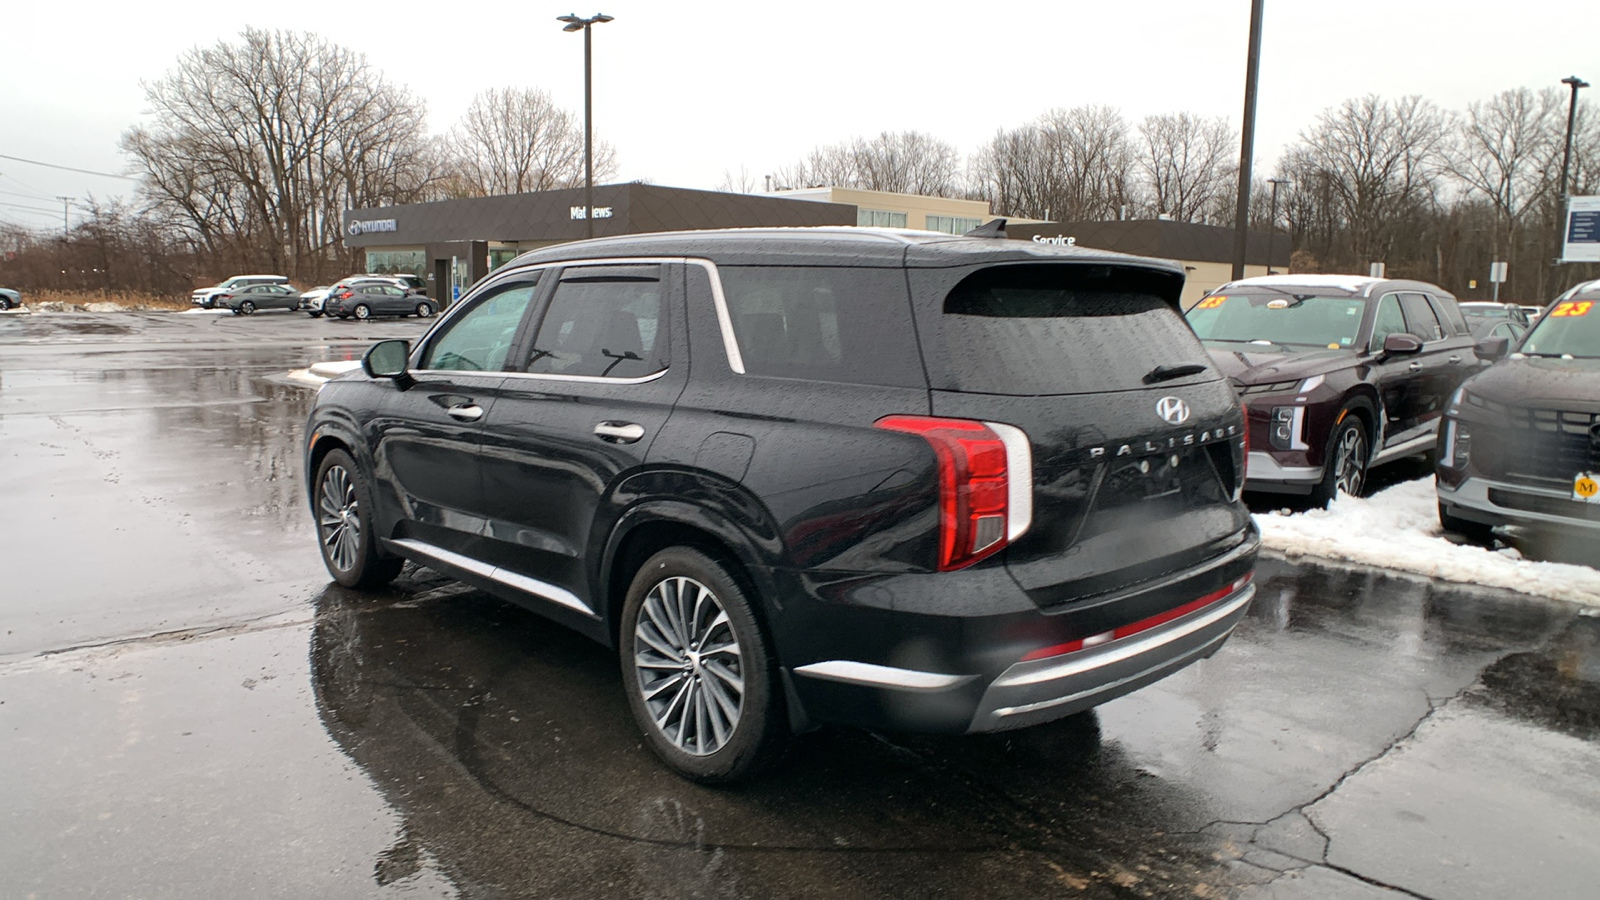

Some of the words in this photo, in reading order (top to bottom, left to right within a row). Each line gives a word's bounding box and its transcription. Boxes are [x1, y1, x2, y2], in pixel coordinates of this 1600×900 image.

[570, 205, 613, 220] Matews
[361, 219, 397, 233] HYUNDAI
[1032, 234, 1076, 247] Service
[1197, 295, 1227, 309] 23
[1551, 301, 1592, 316] 23
[1090, 425, 1236, 458] PALISADE
[1579, 482, 1593, 493] M
